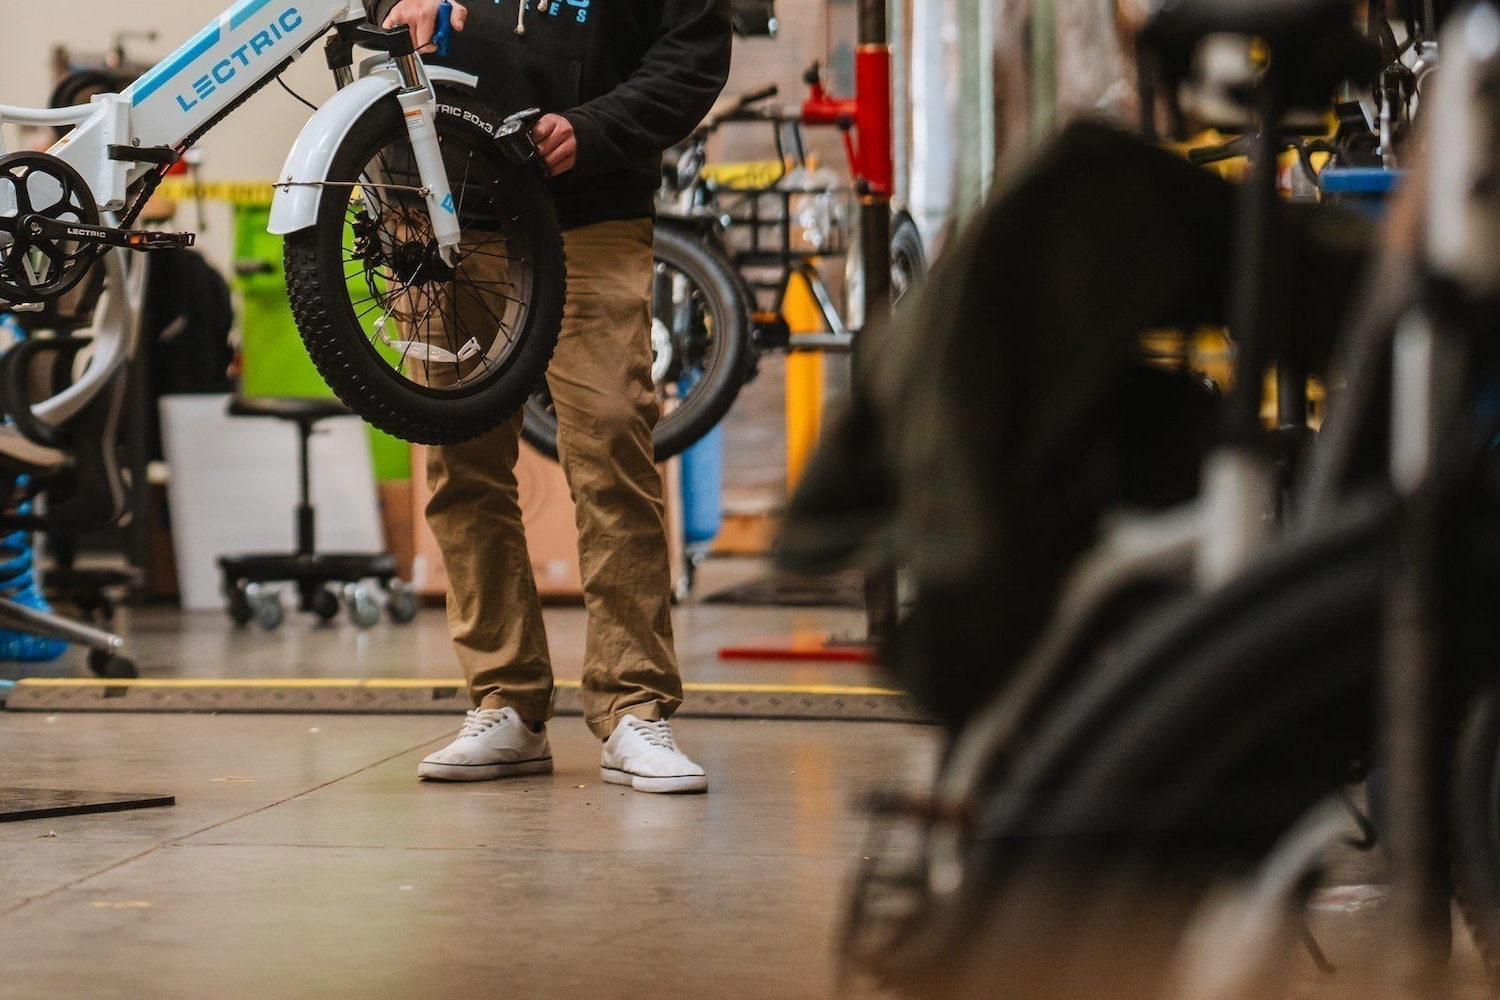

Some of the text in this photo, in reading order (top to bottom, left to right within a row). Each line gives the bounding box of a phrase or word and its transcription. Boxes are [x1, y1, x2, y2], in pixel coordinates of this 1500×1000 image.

[176, 7, 303, 113] LECTRIC
[436, 103, 495, 136] TRIC 20x3.
[67, 227, 107, 238] LECTRIC
